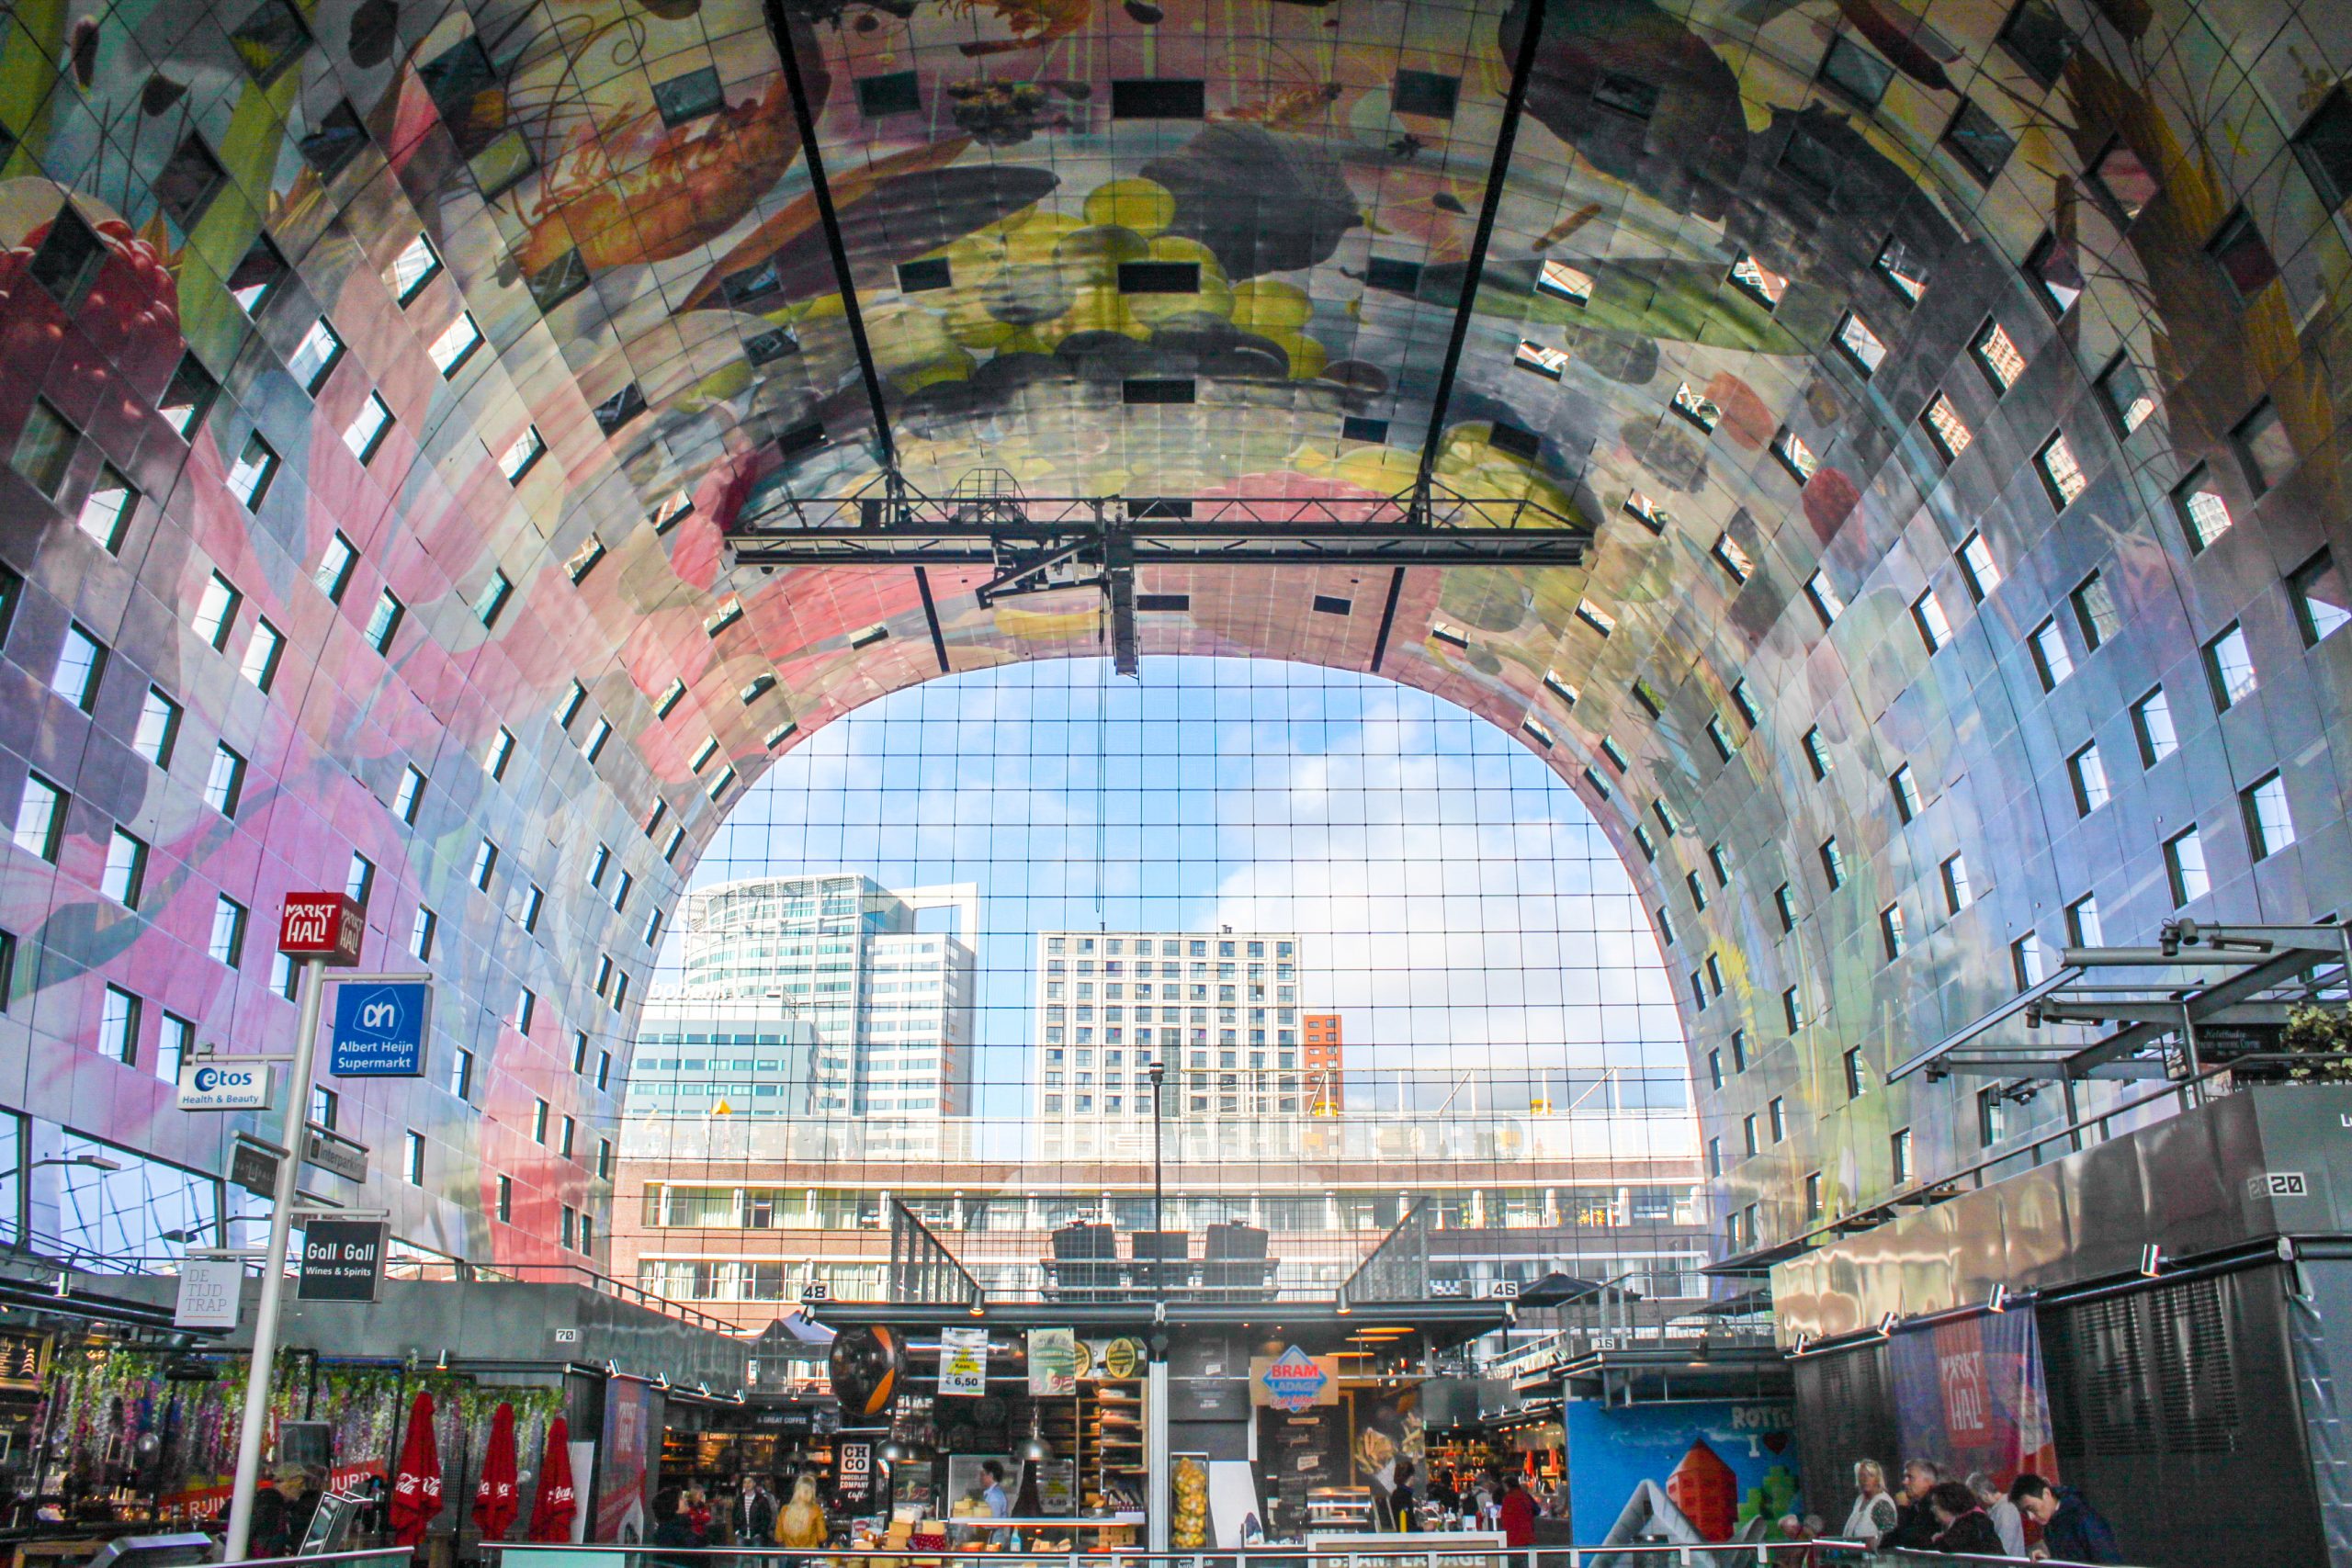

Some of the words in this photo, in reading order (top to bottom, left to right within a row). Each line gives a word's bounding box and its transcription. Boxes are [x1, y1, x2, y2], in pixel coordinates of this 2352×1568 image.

[284, 904, 336, 918] MARKT
[286, 921, 325, 942] HAL
[338, 1042, 377, 1053] Albert
[381, 1042, 413, 1055] Heijn
[338, 1057, 412, 1070] Supermarkt
[197, 1068, 253, 1089] etos
[183, 1095, 213, 1104] Health
[216, 1095, 222, 1103] &
[226, 1094, 259, 1105] Beauty
[2270, 1176, 2303, 1194] 20
[307, 1242, 337, 1260] Gall
[344, 1243, 375, 1261] Gall
[188, 1269, 209, 1282] DE
[305, 1266, 332, 1276] Wines
[334, 1267, 342, 1276] &
[344, 1267, 371, 1277] Spirits
[187, 1284, 222, 1297] TIJD
[802, 1285, 826, 1299] 48
[186, 1298, 228, 1312] TRAP
[558, 1330, 574, 1340] 70
[1272, 1364, 1319, 1378] BRAM
[1940, 1351, 1981, 1381] MARKT
[954, 1377, 978, 1387] 6,50
[1952, 1388, 1984, 1431] HAL
[784, 1416, 808, 1425] COFFEE
[843, 1446, 868, 1459] CH
[1747, 1434, 1760, 1458] I
[844, 1459, 865, 1471] CO
[840, 1481, 869, 1489] COMPANY
